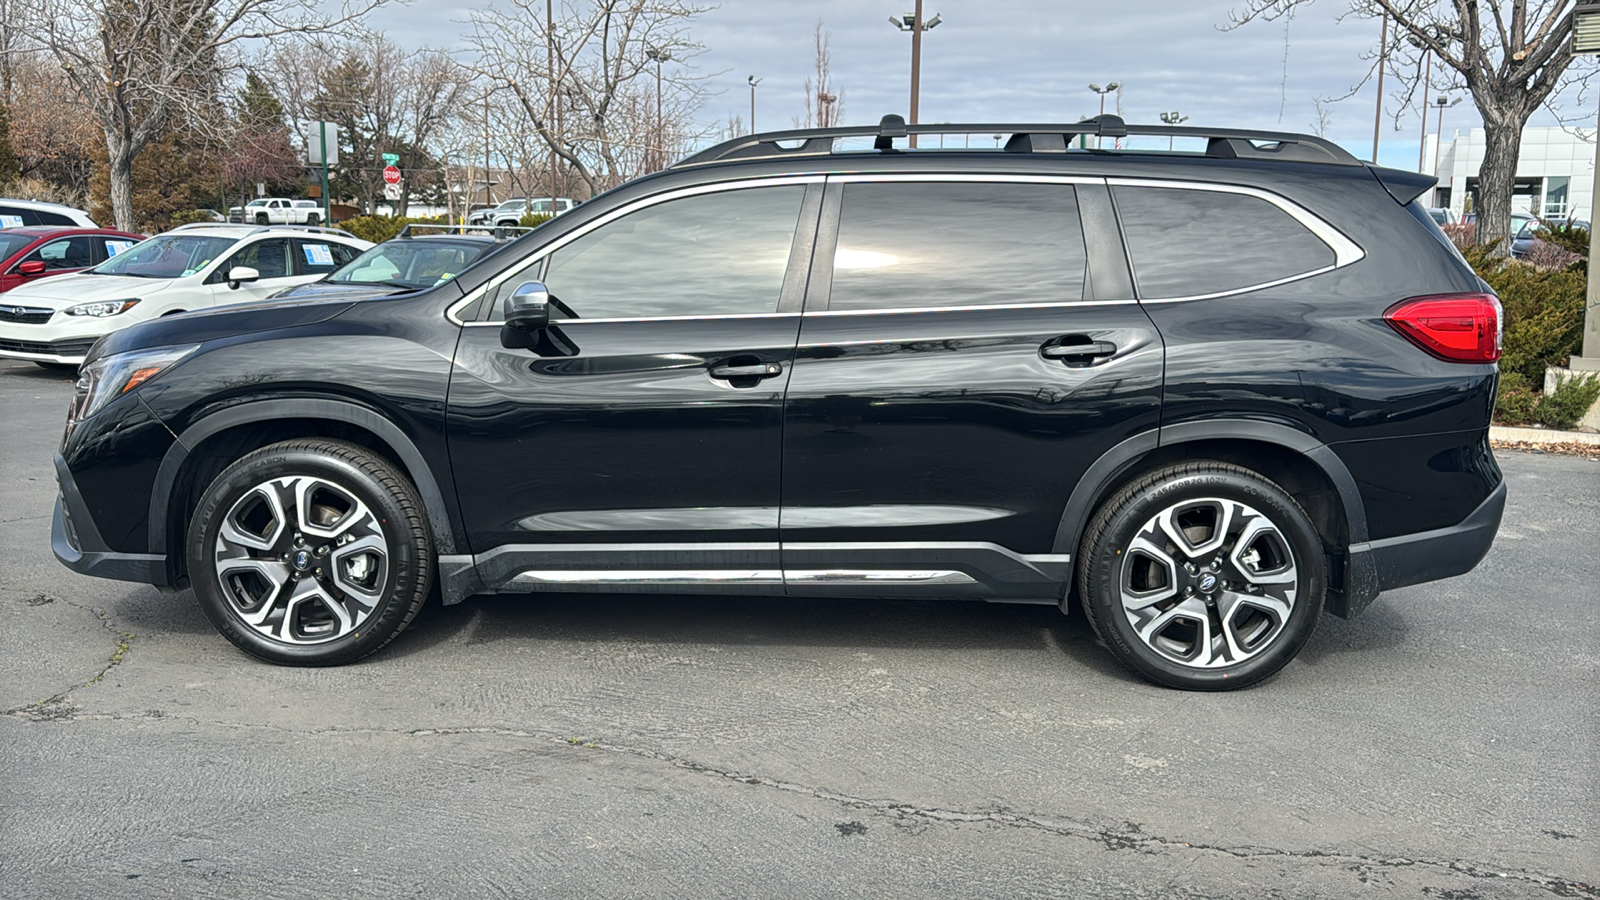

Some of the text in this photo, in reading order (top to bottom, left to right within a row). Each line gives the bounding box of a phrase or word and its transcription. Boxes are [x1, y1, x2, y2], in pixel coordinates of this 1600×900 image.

[385, 171, 400, 179] STOP
[248, 456, 287, 471] SEASON
[1151, 478, 1203, 499] 245/50R20
[1106, 620, 1131, 655] OUTSIDE
